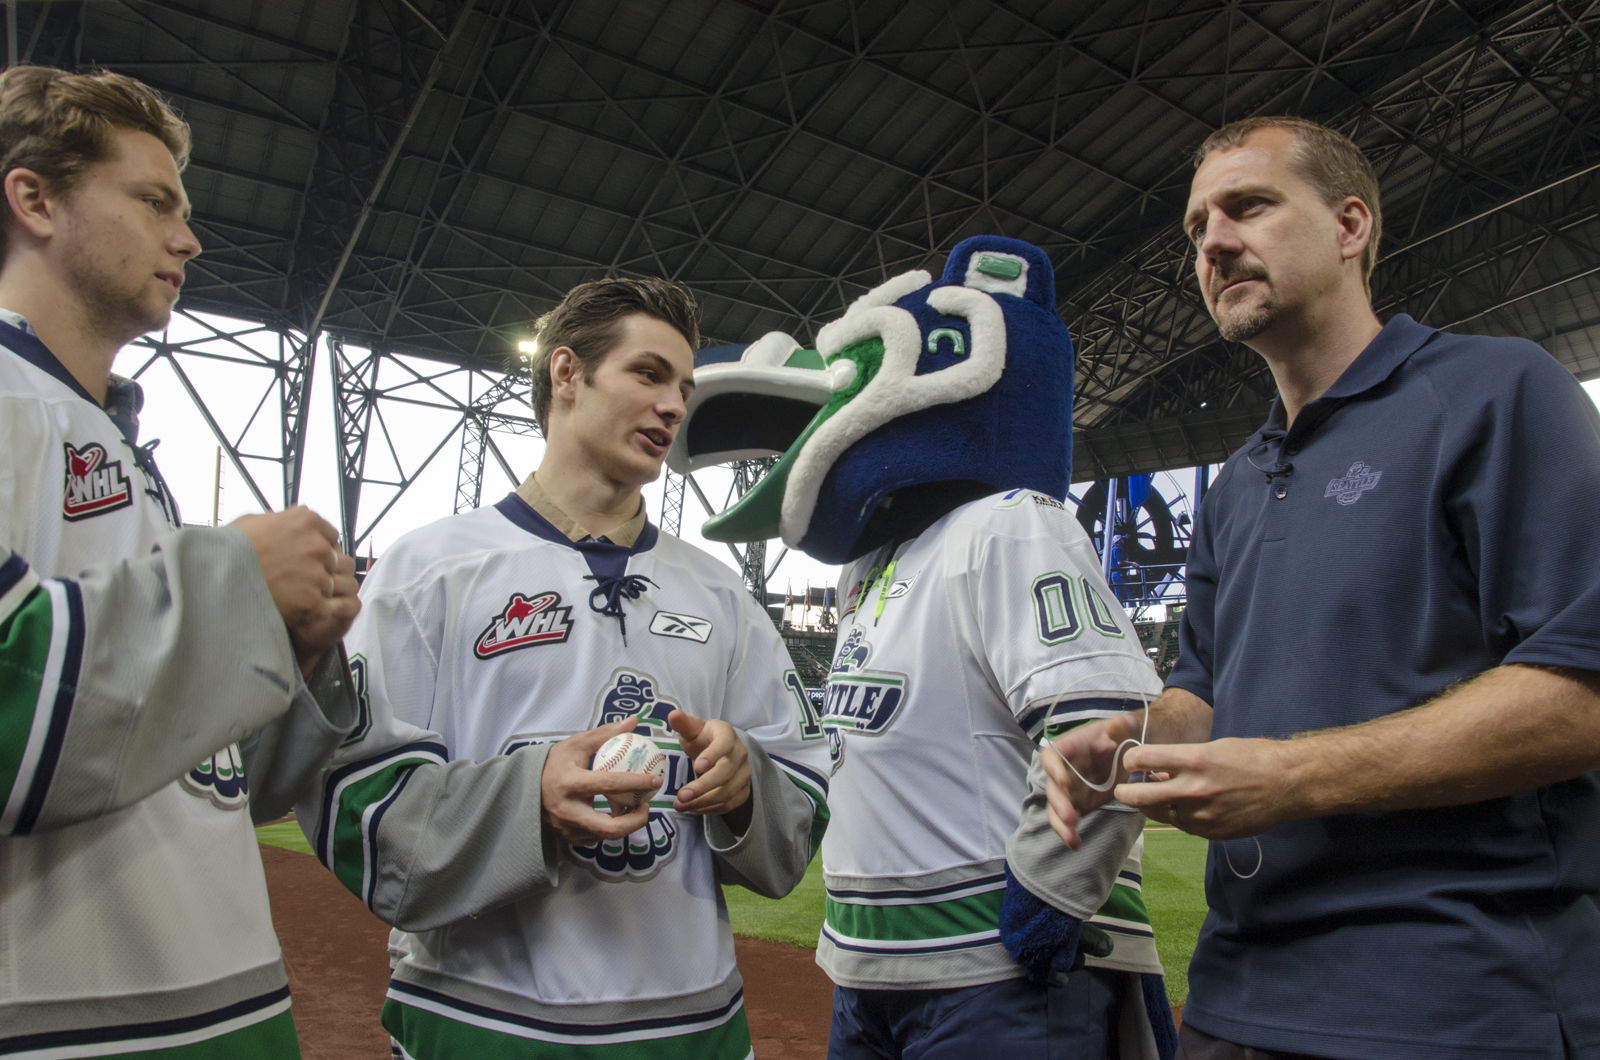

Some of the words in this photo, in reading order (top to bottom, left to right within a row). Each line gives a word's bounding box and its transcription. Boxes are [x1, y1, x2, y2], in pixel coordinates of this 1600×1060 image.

[66, 466, 127, 503] WHL
[1331, 476, 1373, 492] SEATTLE
[495, 609, 569, 642] WHL
